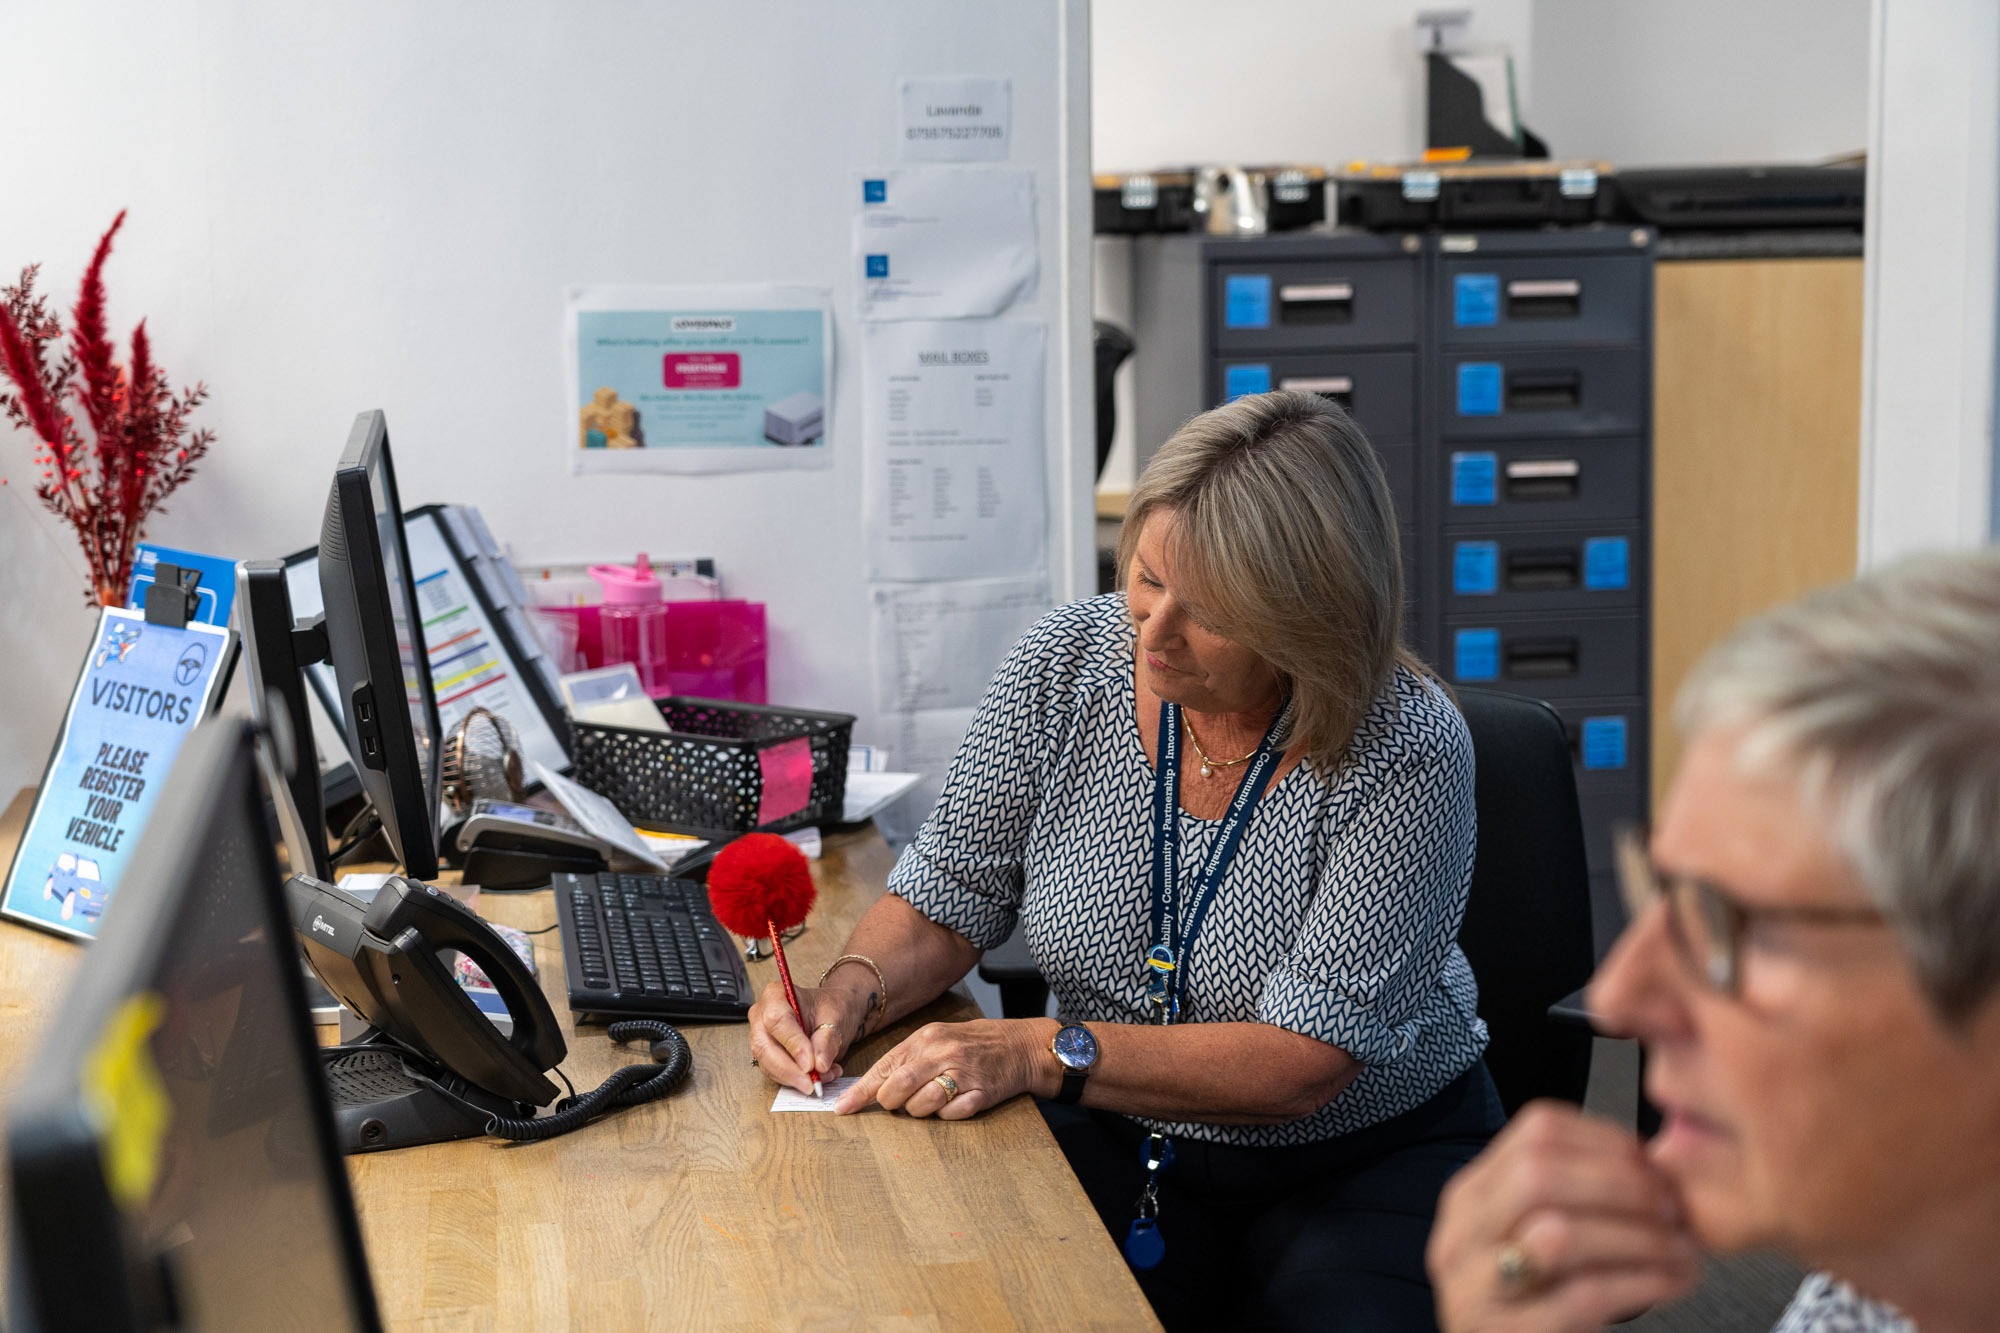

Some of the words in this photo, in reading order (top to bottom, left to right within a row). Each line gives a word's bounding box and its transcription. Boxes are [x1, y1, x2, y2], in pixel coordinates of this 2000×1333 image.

[918, 350, 949, 364] MAIL
[952, 350, 990, 364] BOXES
[92, 677, 193, 725] VISITORS
[1165, 702, 1175, 760] Innovation
[94, 741, 149, 775] PLEASE
[79, 765, 146, 803] REGISTER
[1162, 768, 1176, 831] Partnership
[1233, 752, 1270, 811] Community
[84, 793, 124, 825] YOUR
[65, 816, 125, 853] VEHICLE
[1205, 817, 1238, 876] Partnership
[1162, 840, 1174, 903] Community
[320, 921, 335, 936] MITEL
[1182, 883, 1209, 938] Innovation
[1174, 946, 1185, 989] Respect
